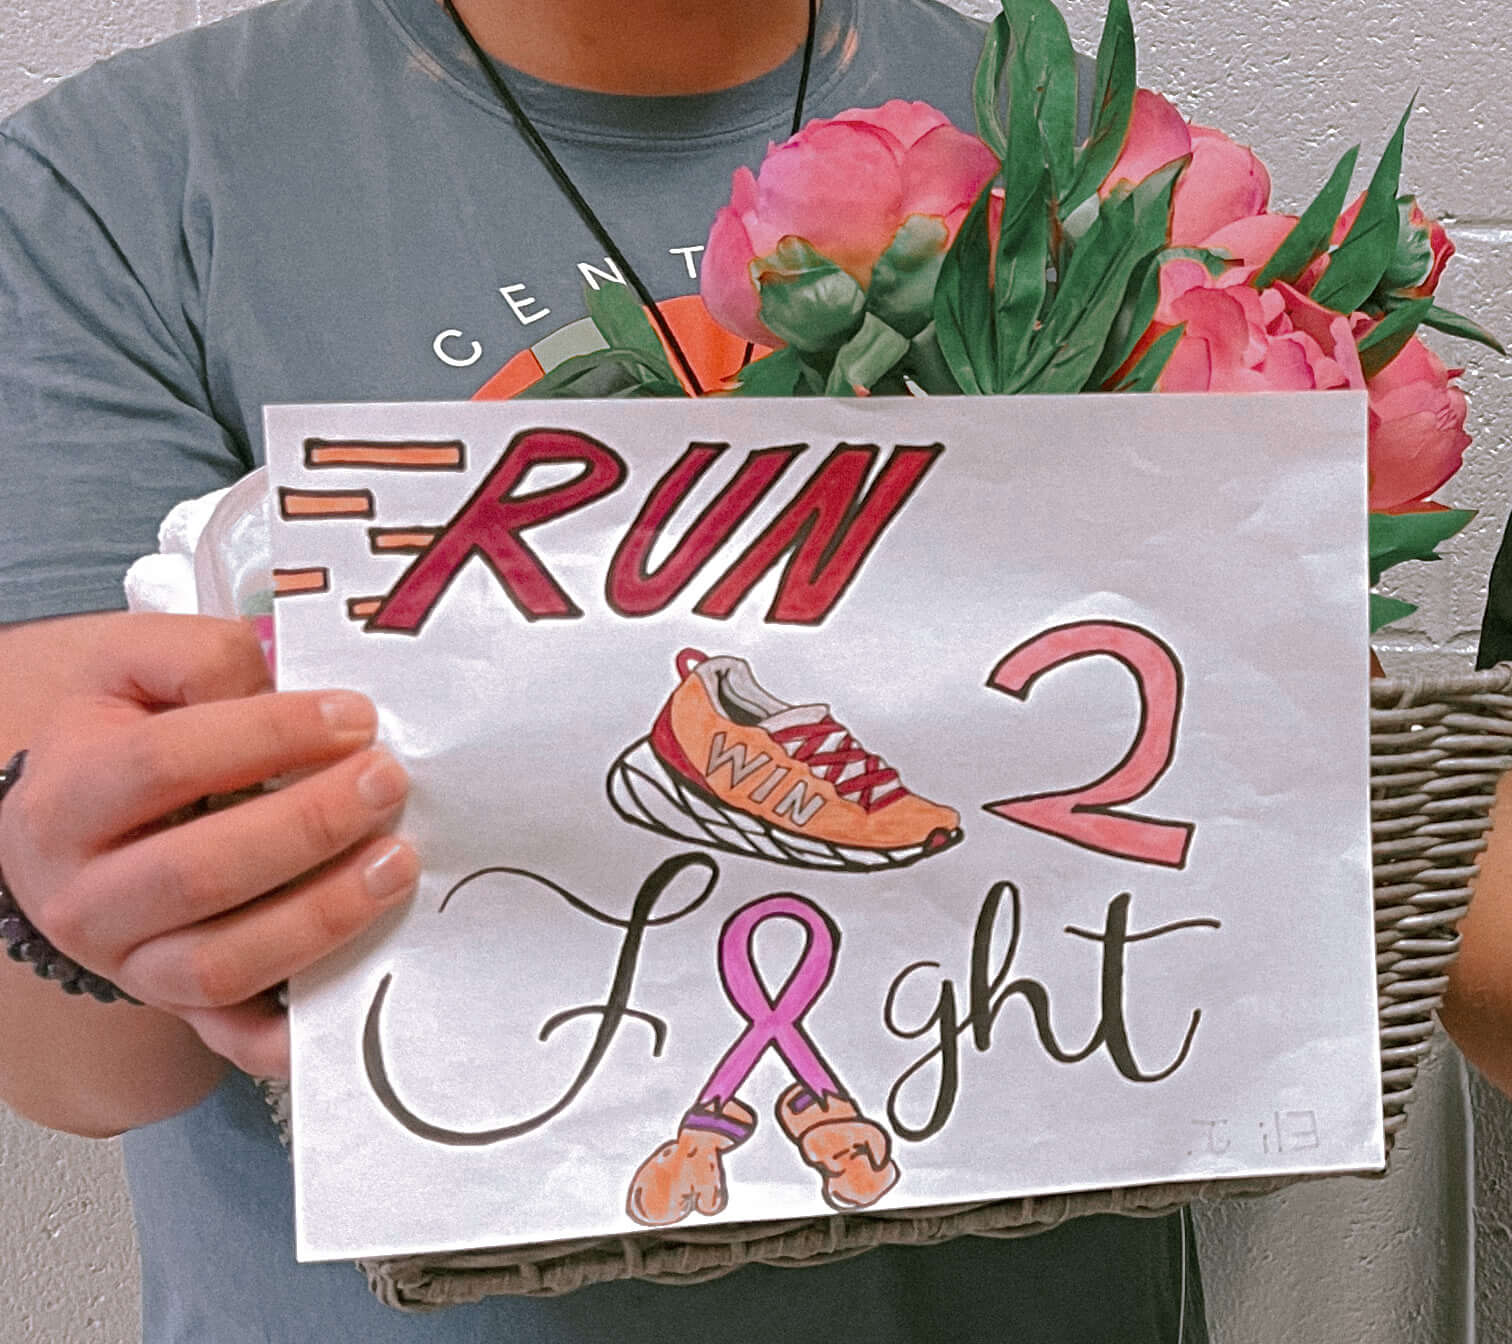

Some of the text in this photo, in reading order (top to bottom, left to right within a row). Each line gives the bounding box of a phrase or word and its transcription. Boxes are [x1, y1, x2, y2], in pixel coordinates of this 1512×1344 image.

[362, 428, 946, 635] RUN
[705, 730, 828, 828] WIN
[982, 618, 1197, 870] 2
